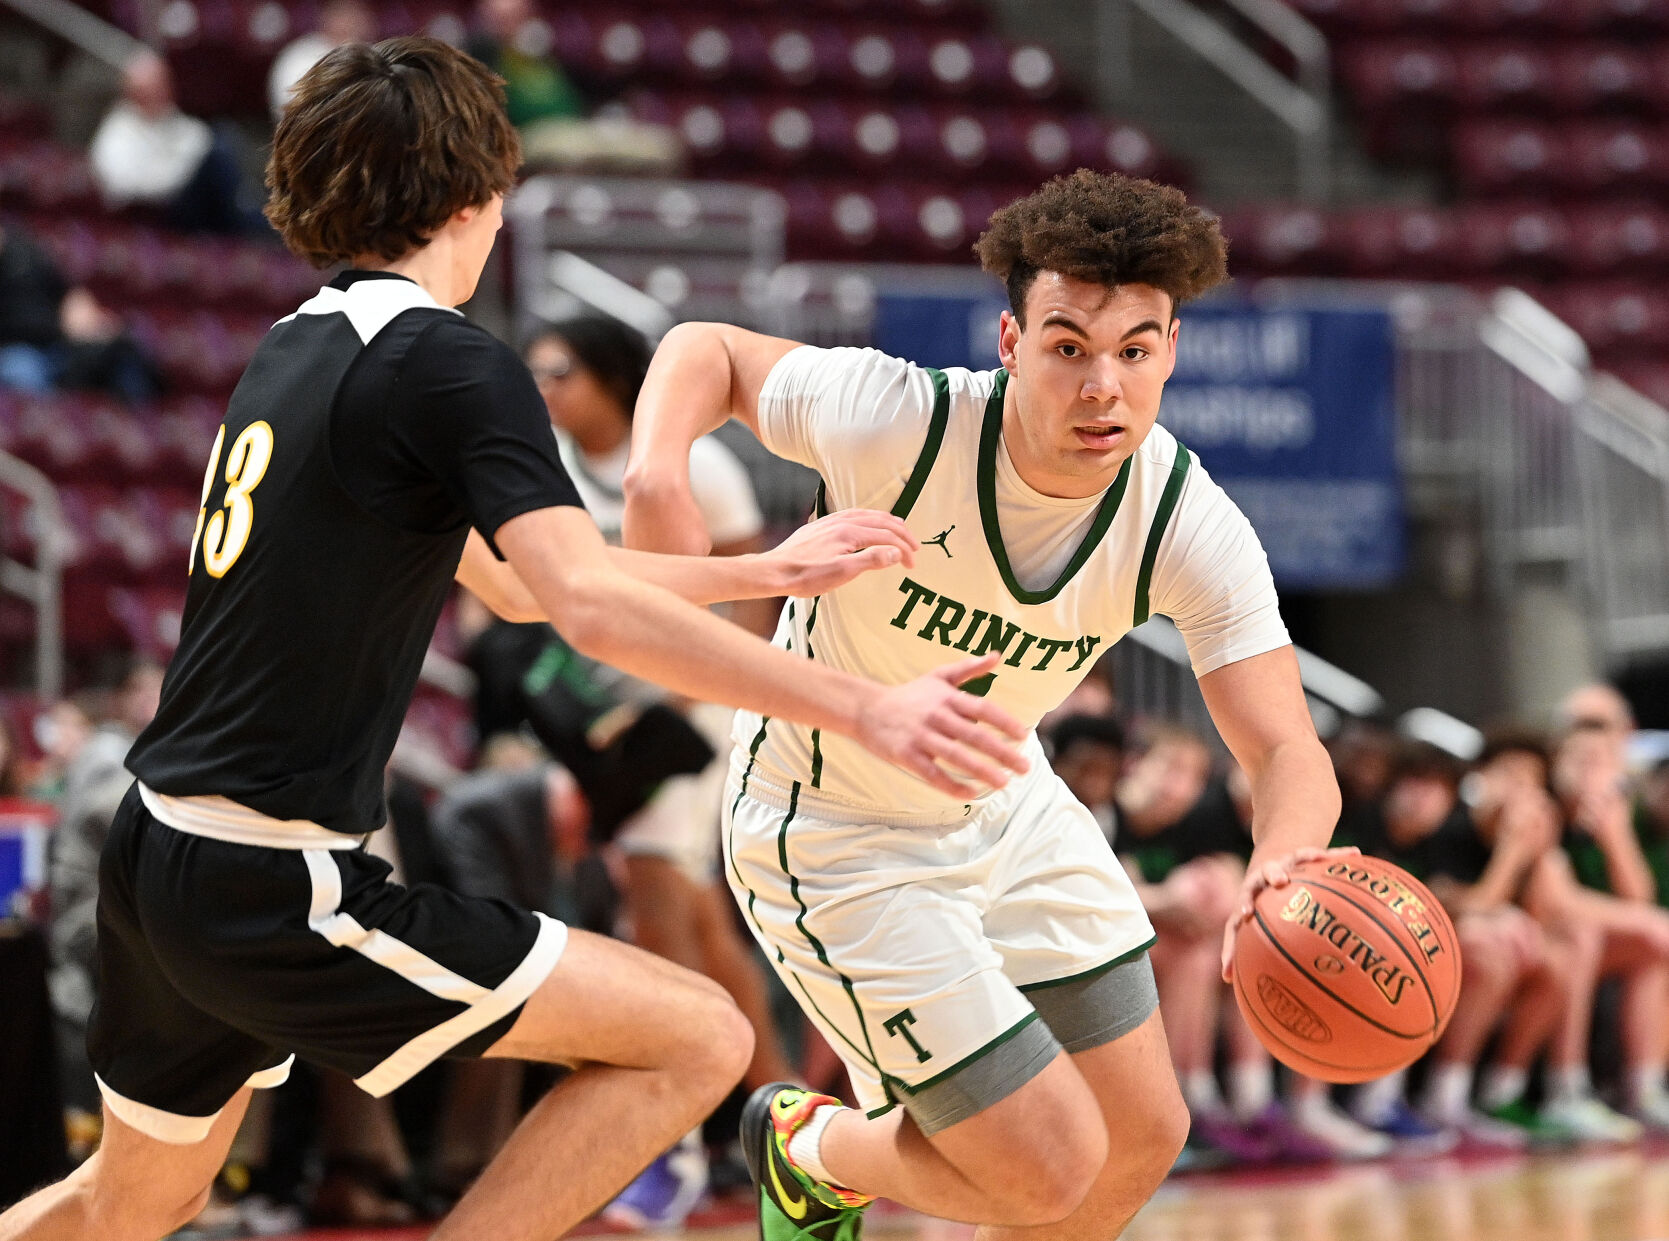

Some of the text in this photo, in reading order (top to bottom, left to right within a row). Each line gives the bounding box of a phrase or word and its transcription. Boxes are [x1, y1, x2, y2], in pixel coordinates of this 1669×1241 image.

[889, 576, 1101, 672] TRINITY
[1281, 887, 1415, 1005] SPALDING
[1327, 864, 1439, 964] TF-1000
[882, 1007, 934, 1064] T
